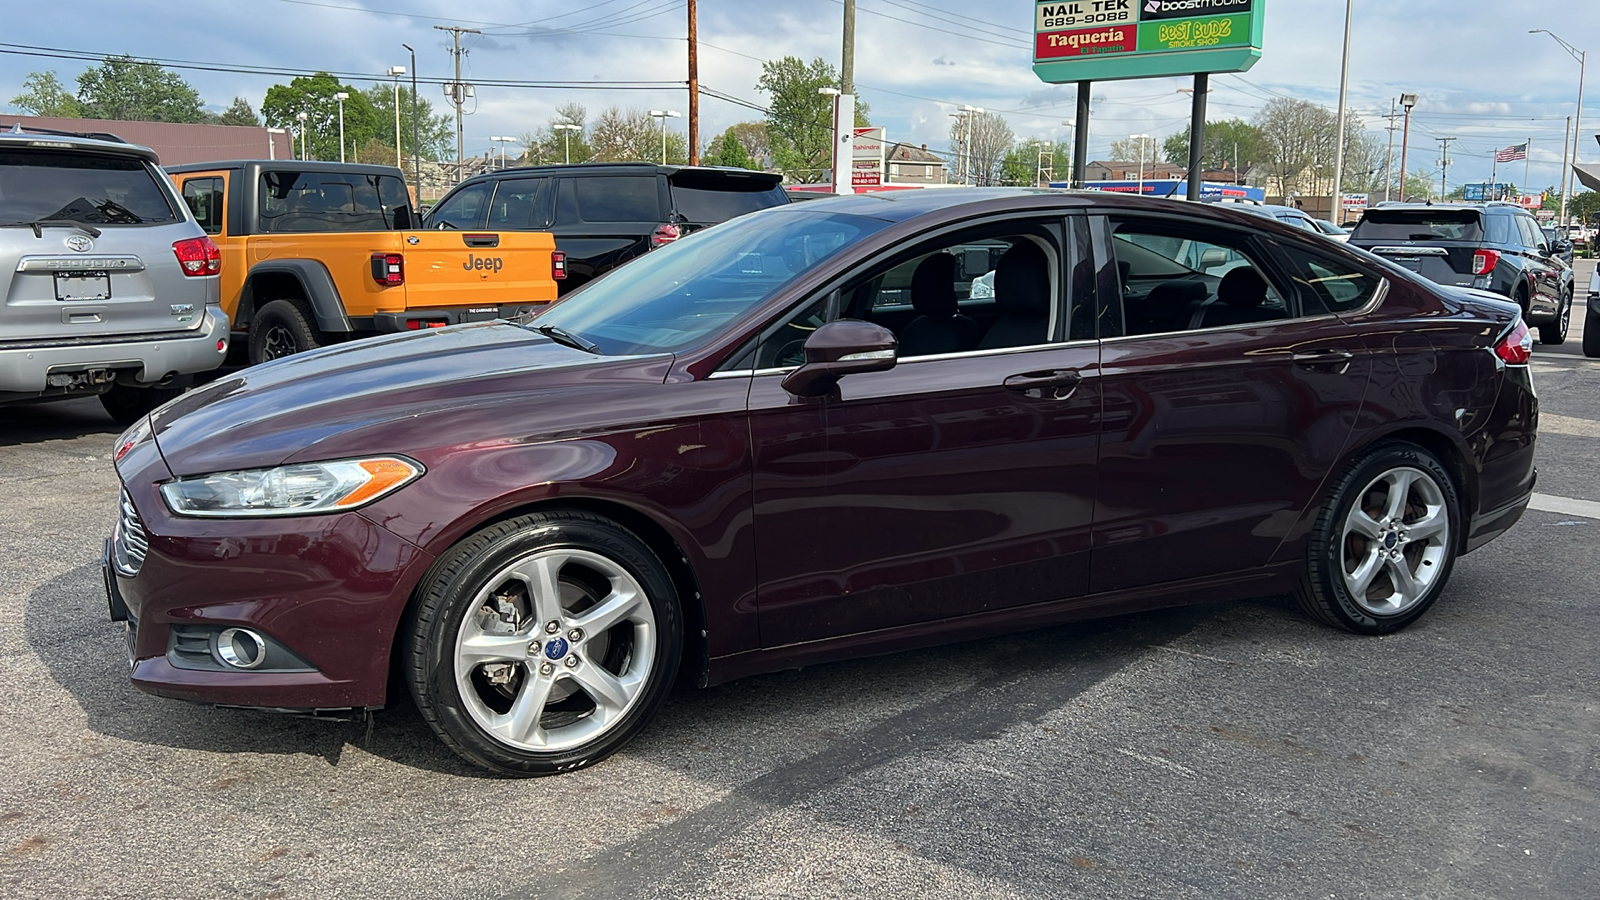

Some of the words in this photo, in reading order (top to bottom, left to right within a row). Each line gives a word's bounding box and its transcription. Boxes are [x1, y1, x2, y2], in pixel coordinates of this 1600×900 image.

[1042, 3, 1083, 17] NAIL
[1091, 0, 1129, 12] TEK
[1044, 11, 1128, 27] 689-9088
[1197, 37, 1219, 46] SHOP
[1080, 46, 1089, 54] El
[46, 259, 121, 268] SEQUOIA
[463, 254, 503, 273] Jeep
